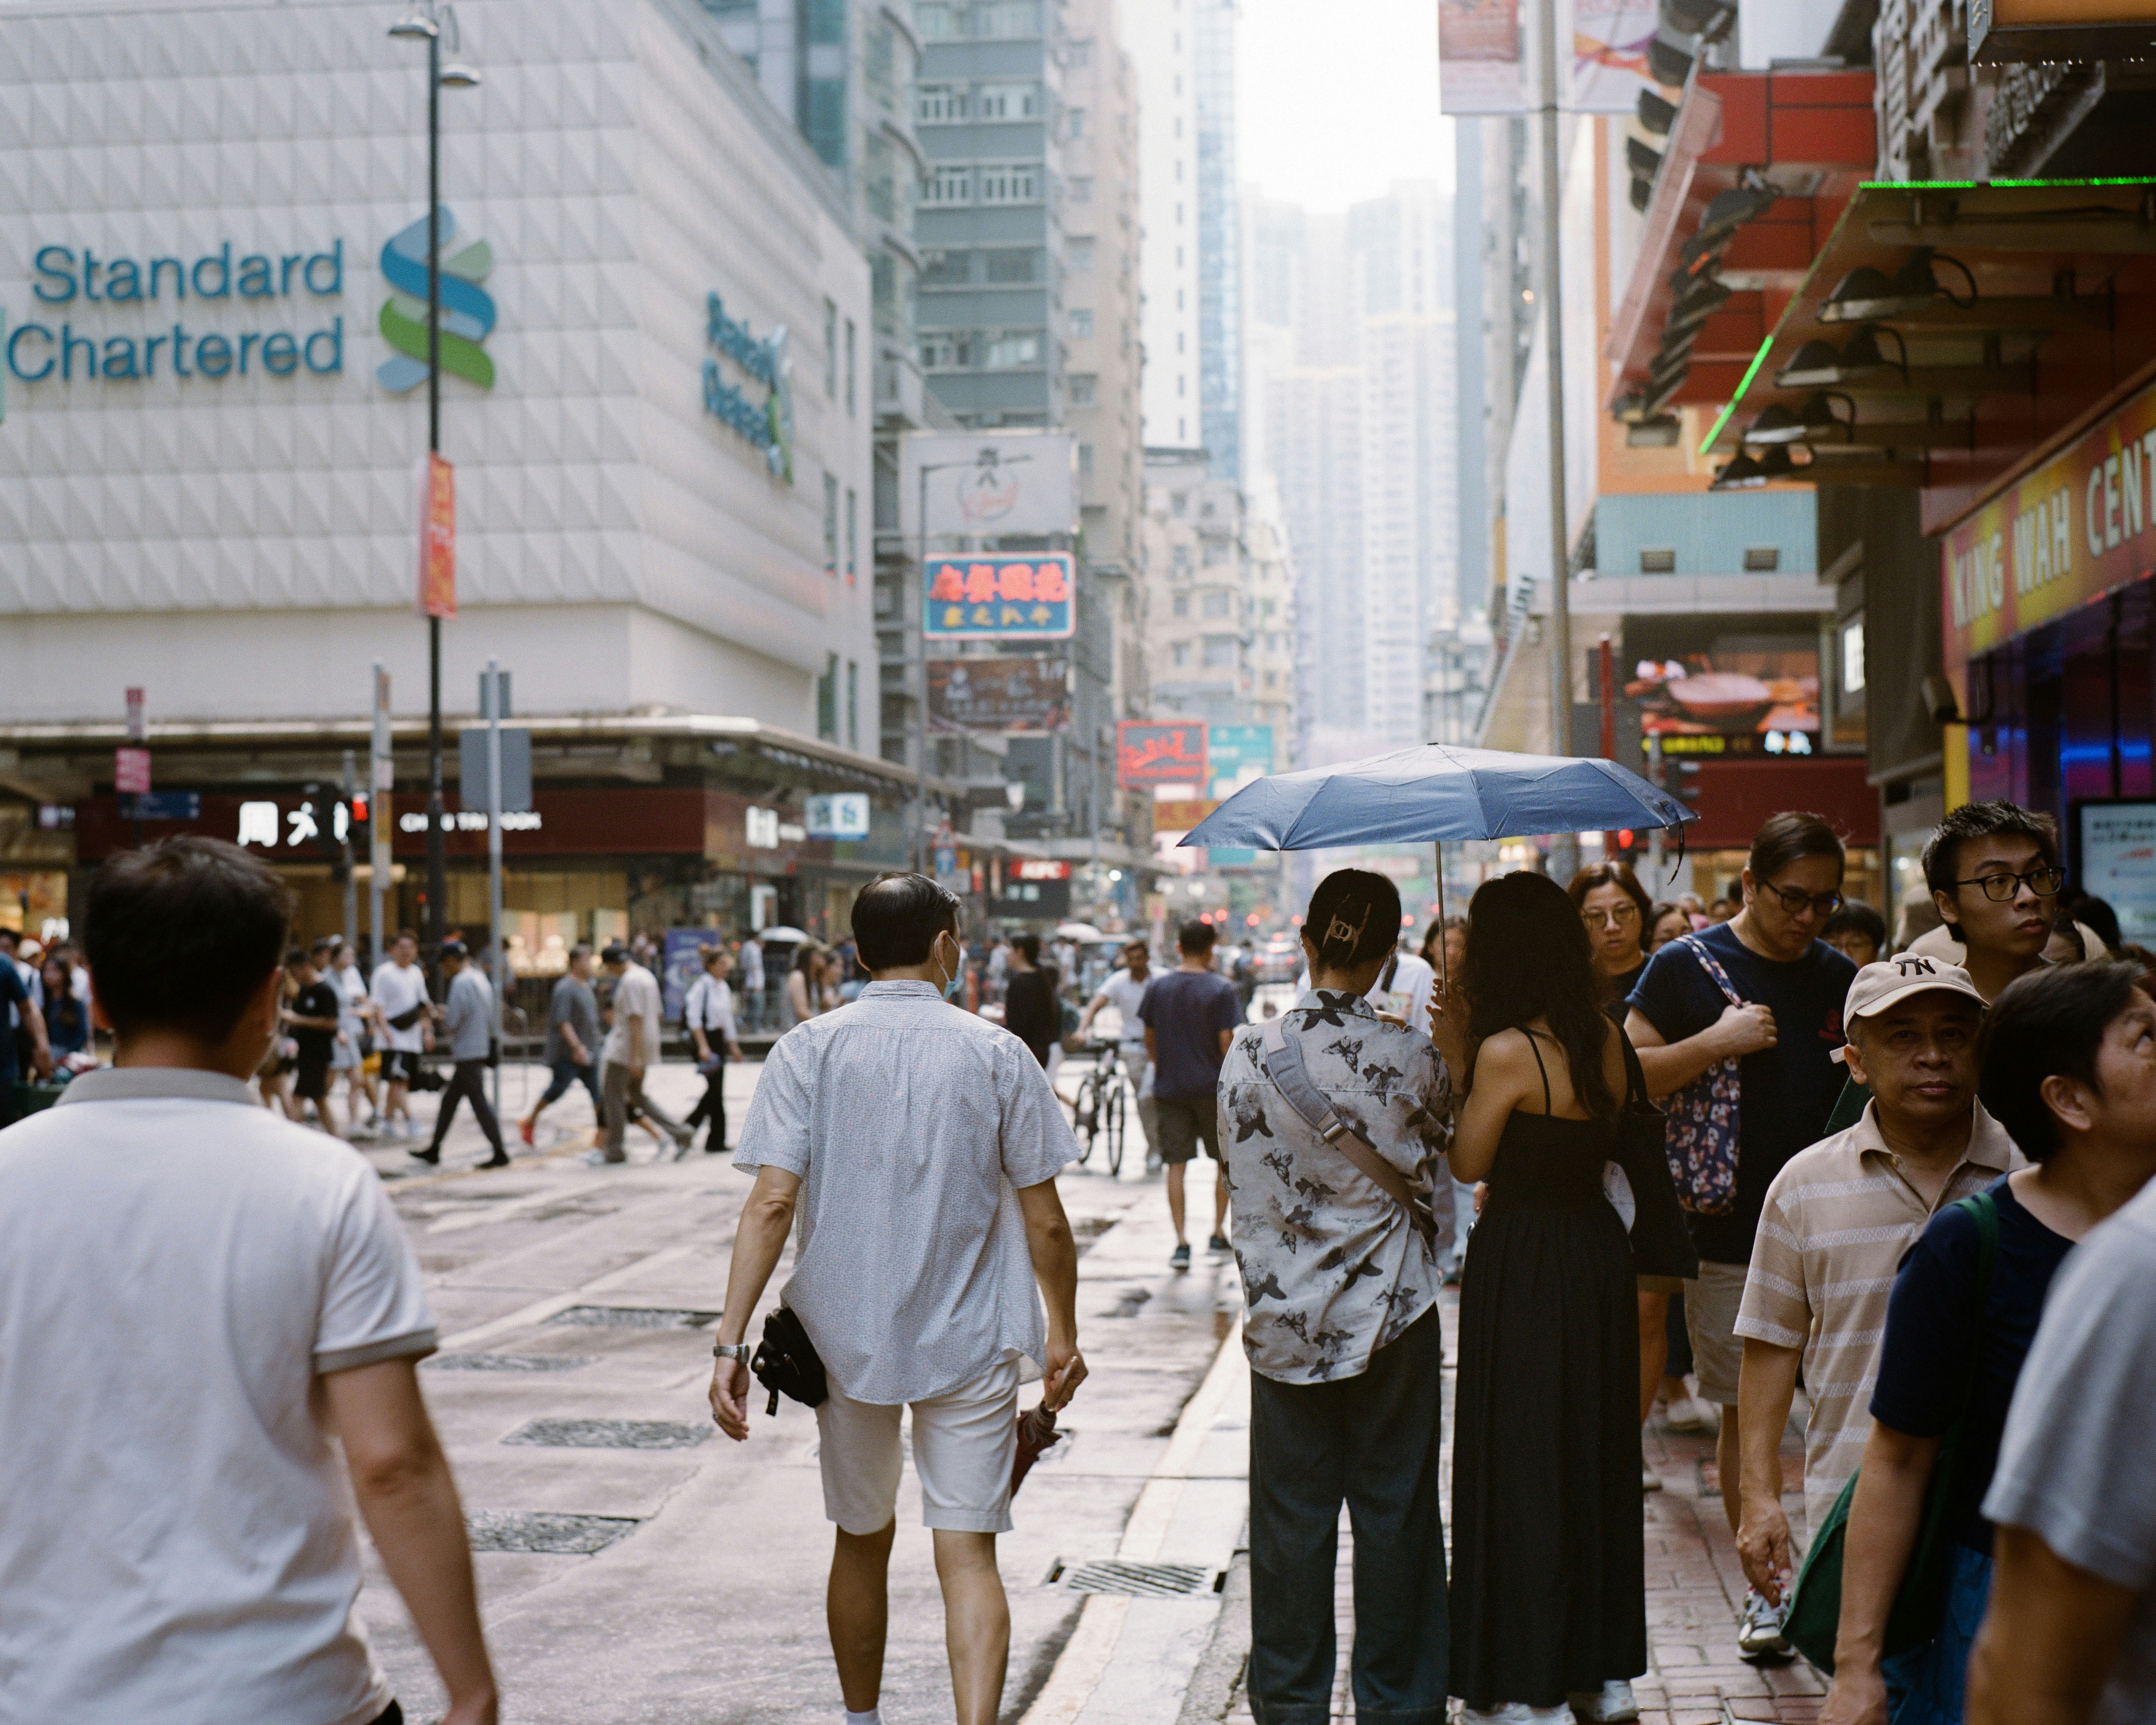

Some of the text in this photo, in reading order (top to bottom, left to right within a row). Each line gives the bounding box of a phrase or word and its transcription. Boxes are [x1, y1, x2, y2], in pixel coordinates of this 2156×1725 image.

[32, 238, 343, 303] Standard
[7, 316, 343, 382] Chartered
[1953, 530, 2004, 630] KING
[2013, 483, 2072, 597] WAH
